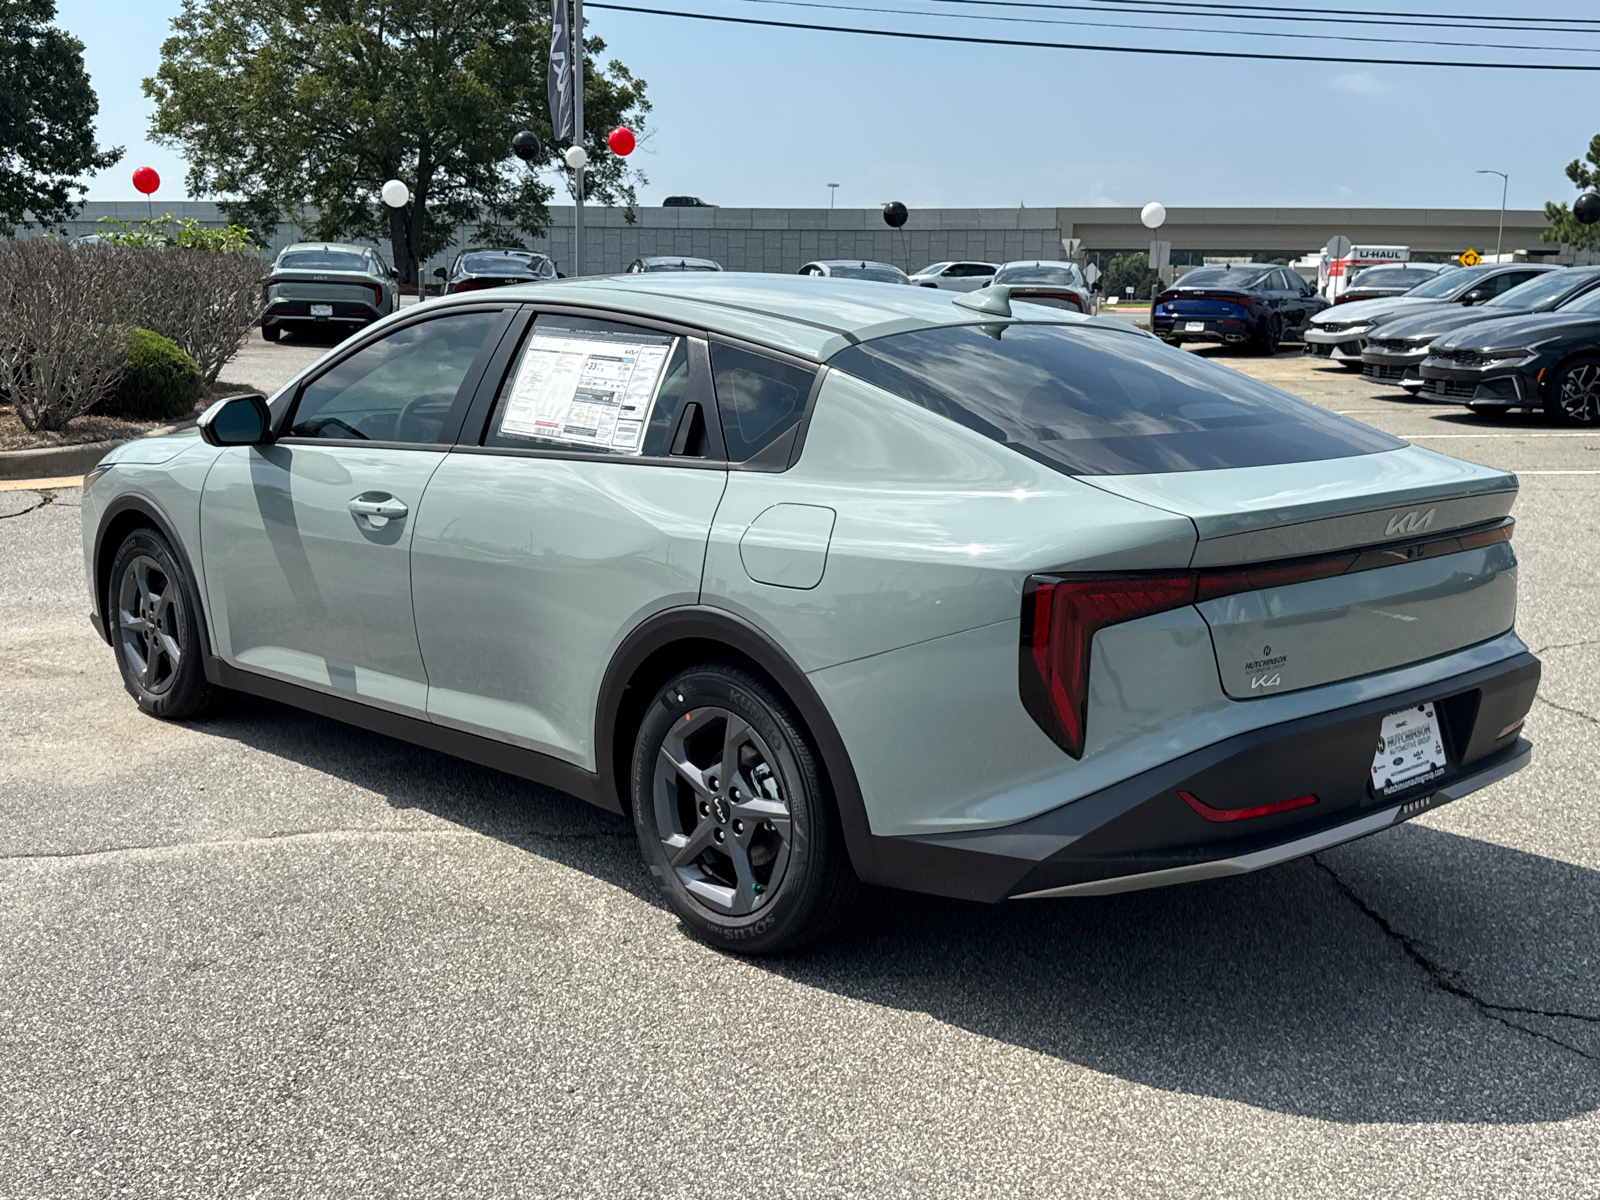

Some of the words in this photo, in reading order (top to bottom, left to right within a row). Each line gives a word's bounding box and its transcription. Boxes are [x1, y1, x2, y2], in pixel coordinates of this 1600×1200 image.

[1360, 251, 1401, 259] U-HAUL
[588, 362, 598, 370] 33
[1384, 508, 1436, 536] KIA
[1245, 655, 1288, 670] HUTCHINSON
[1251, 672, 1281, 689] K4
[730, 689, 782, 751] KUMHO
[1387, 724, 1432, 748] HUTCHINSON
[723, 912, 776, 940] SOLUS
